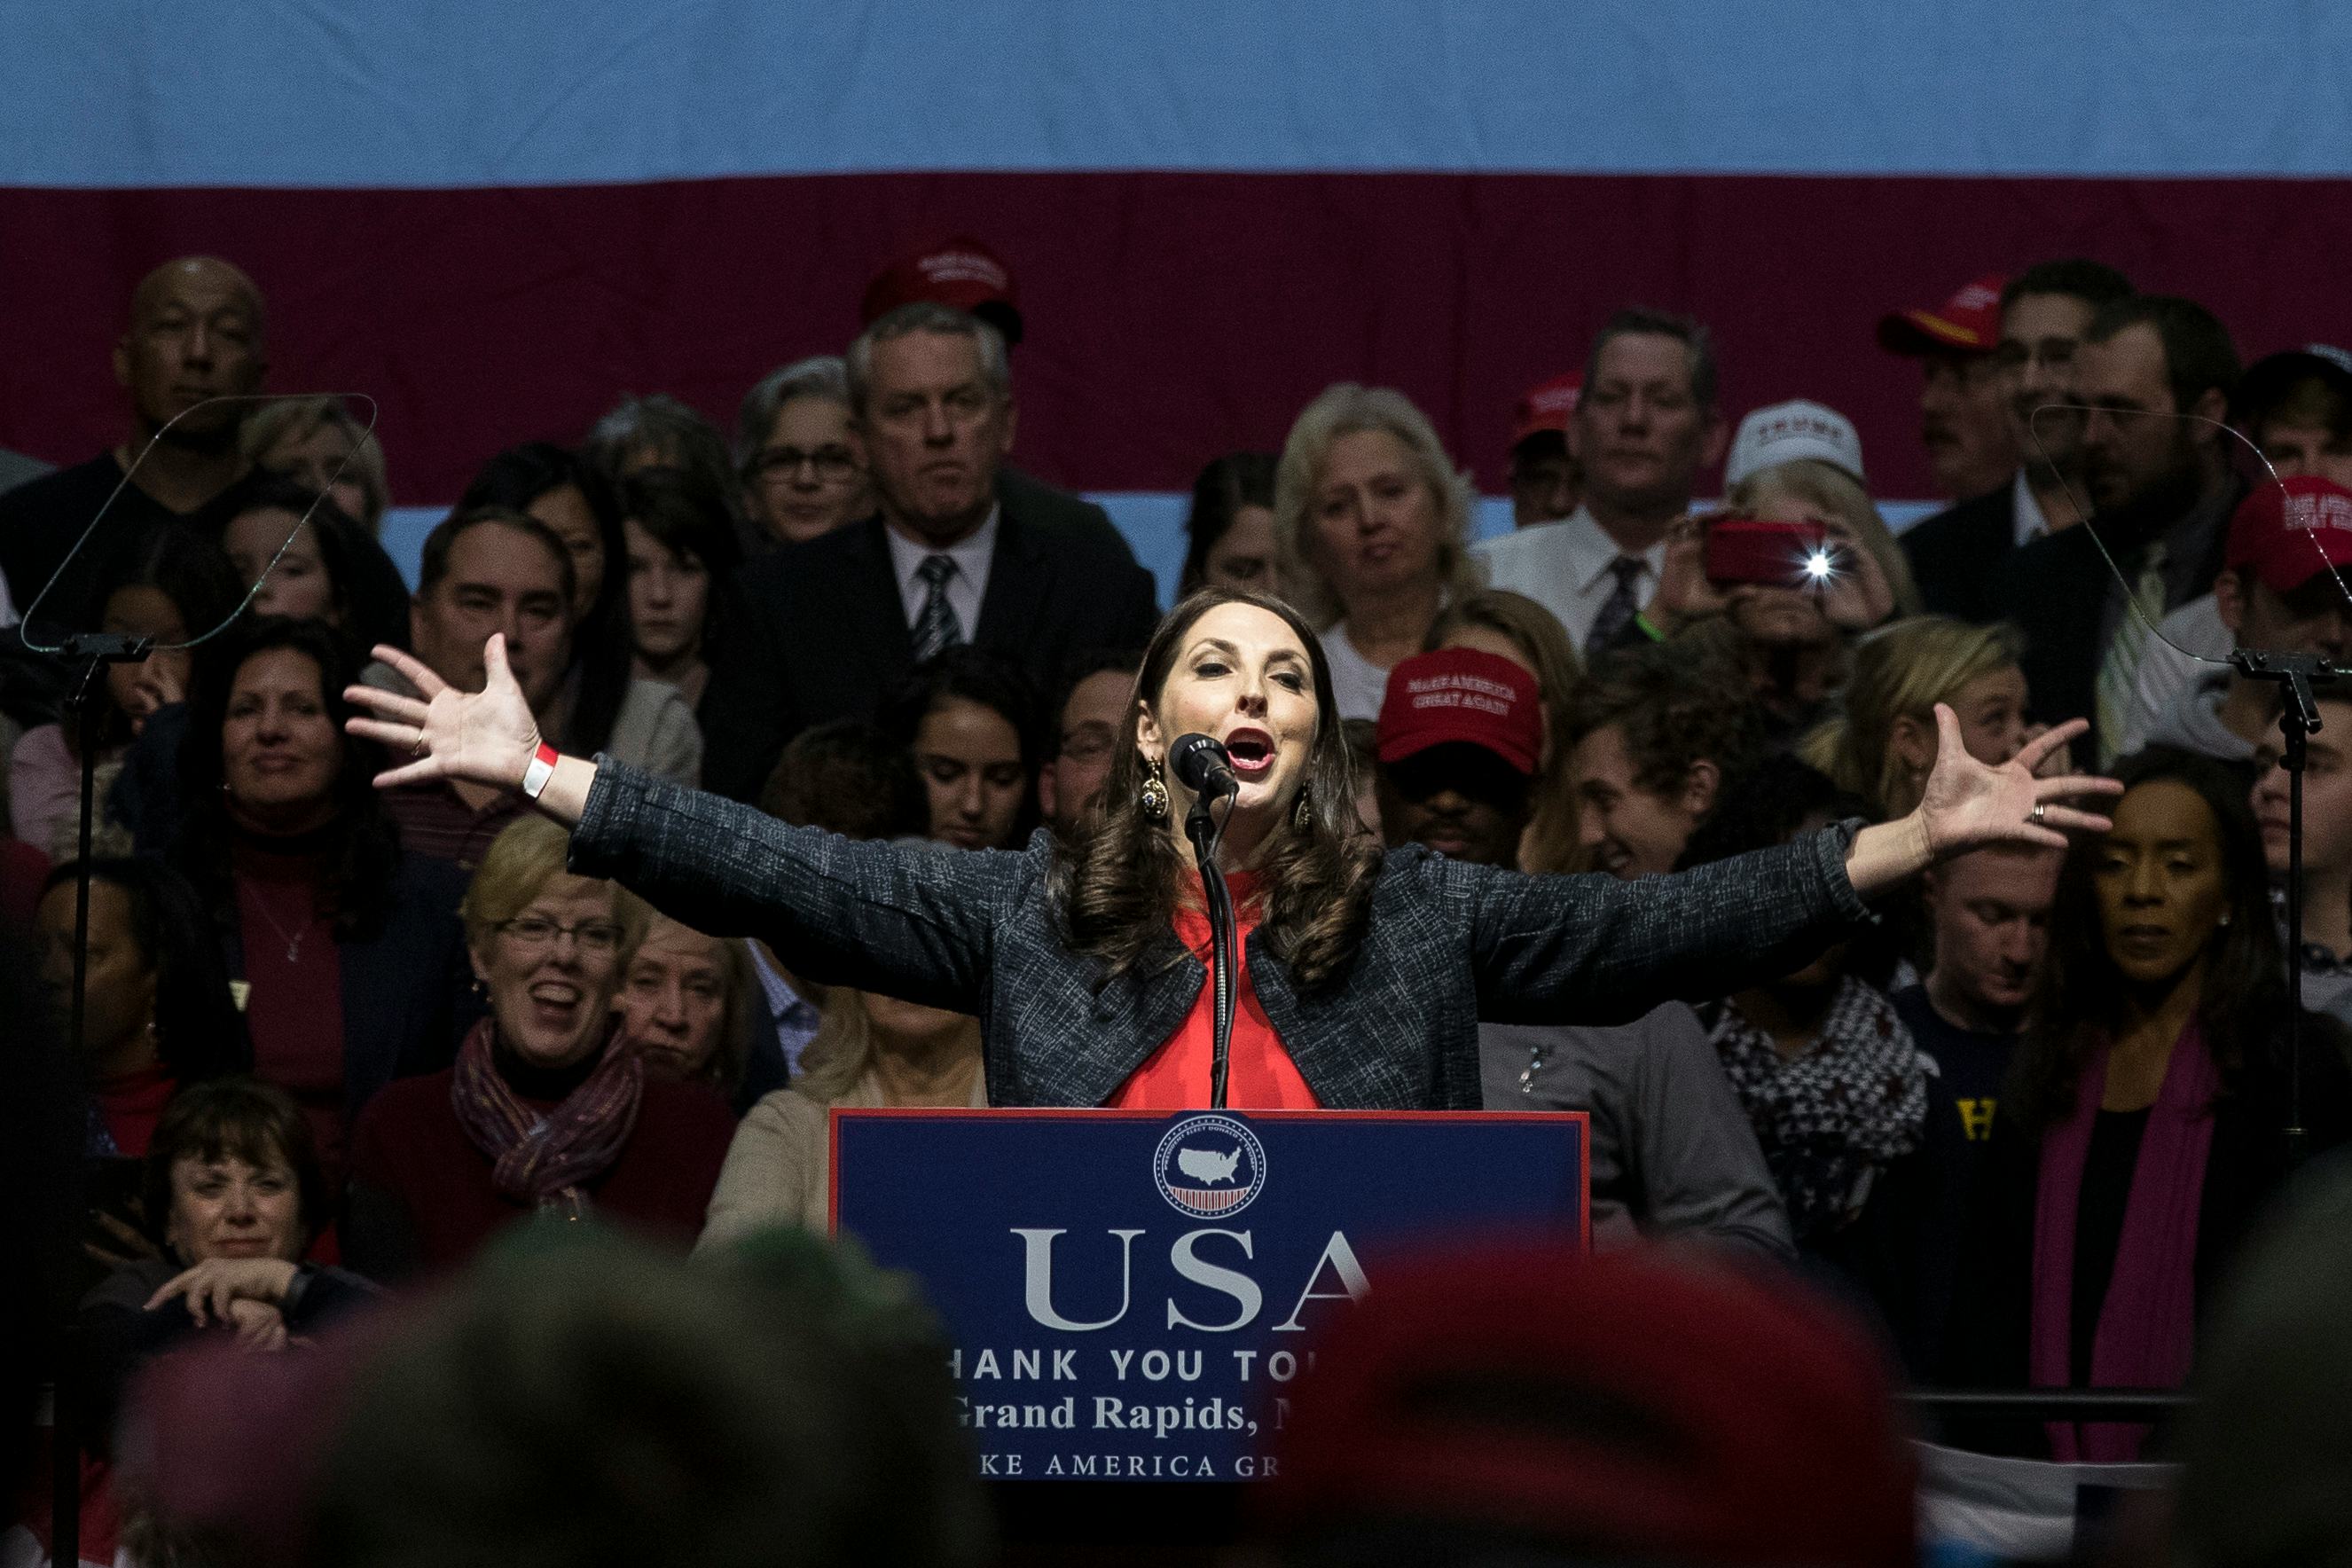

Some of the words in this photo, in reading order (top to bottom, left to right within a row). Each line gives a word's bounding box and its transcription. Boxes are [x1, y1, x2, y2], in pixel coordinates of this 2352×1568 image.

[1413, 693, 1461, 709] GREAT
[1462, 694, 1509, 717] AGAIN
[1208, 1126, 1238, 1139] DONALD
[1243, 1143, 1255, 1171] TRUMP
[1010, 1228, 1372, 1331] USA
[946, 1349, 1078, 1380] HANK
[1109, 1350, 1203, 1381] YOU
[1234, 1351, 1315, 1382] TO
[1092, 1397, 1258, 1439] Rapids,
[980, 1454, 1023, 1475] KE
[1045, 1454, 1215, 1476] AMERICA
